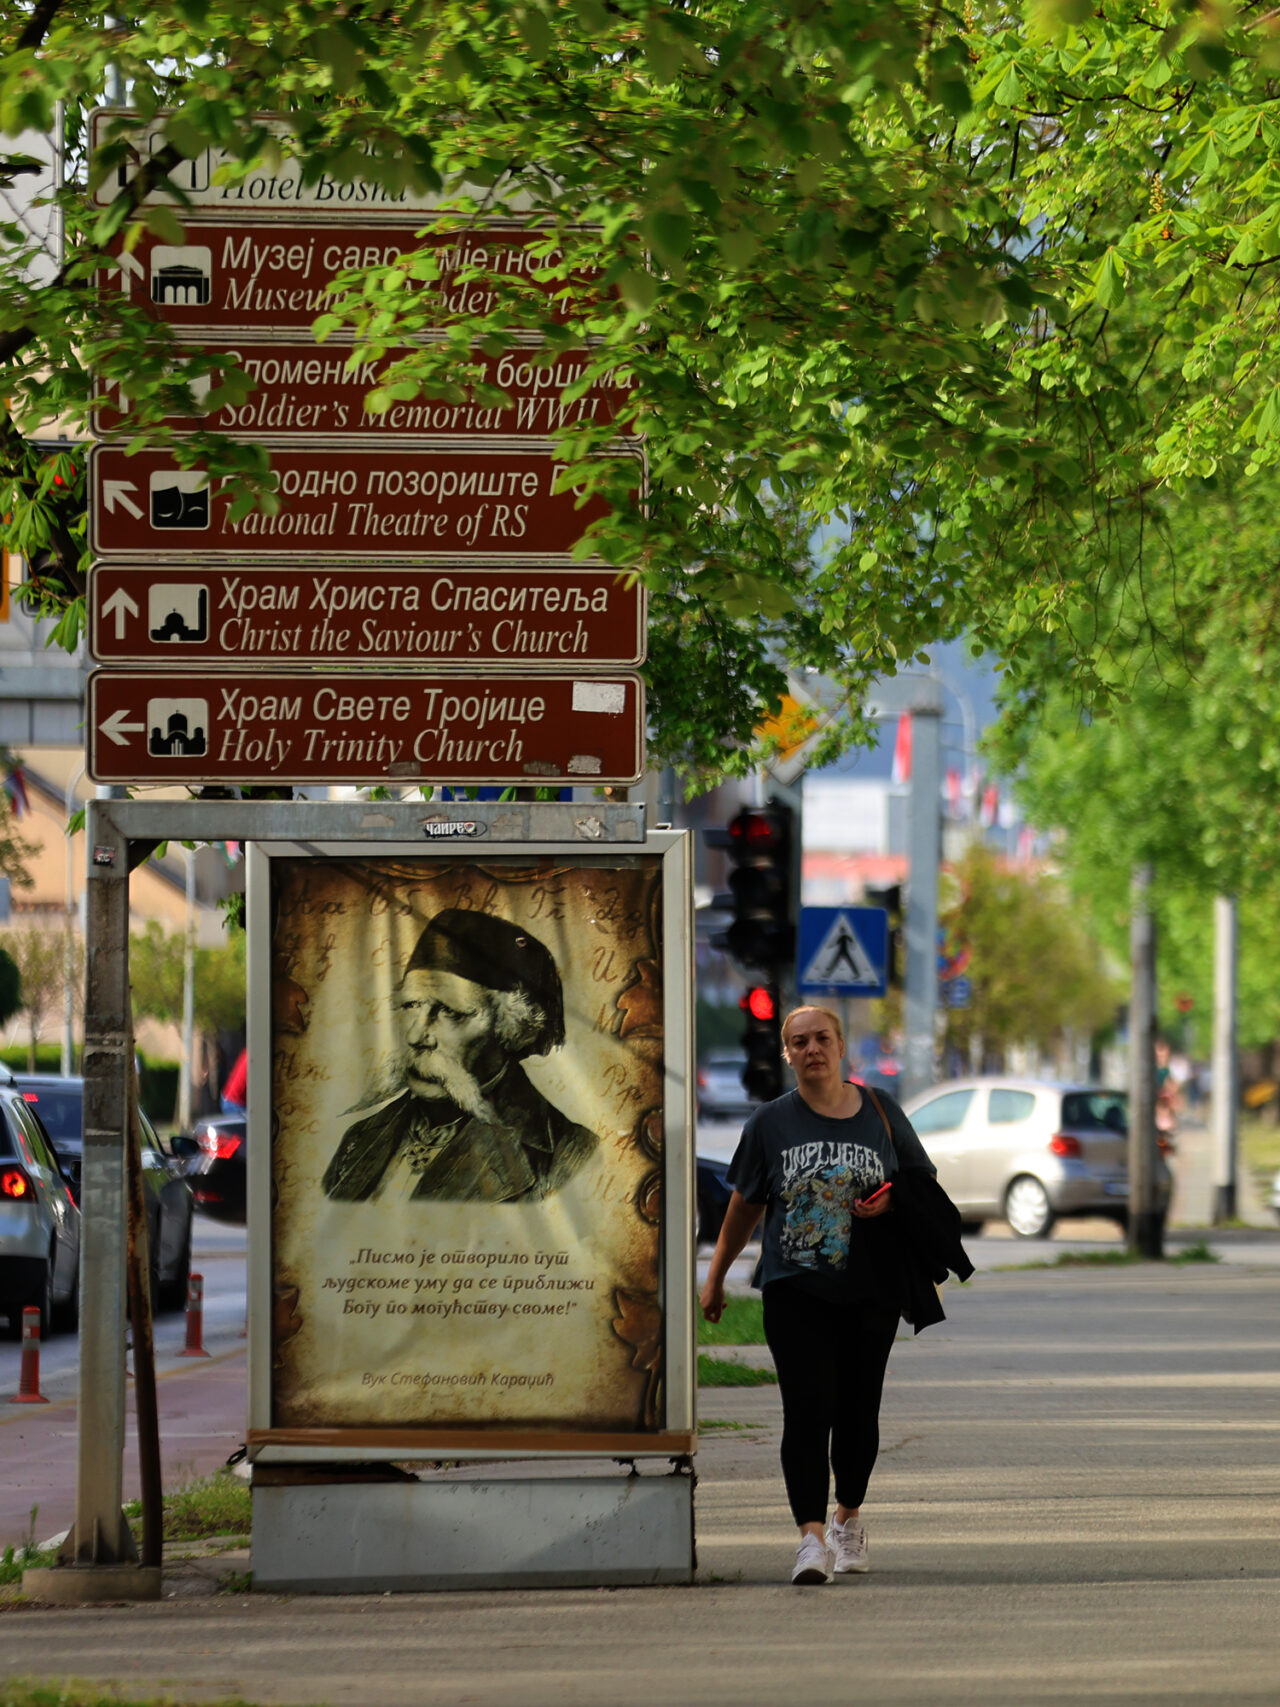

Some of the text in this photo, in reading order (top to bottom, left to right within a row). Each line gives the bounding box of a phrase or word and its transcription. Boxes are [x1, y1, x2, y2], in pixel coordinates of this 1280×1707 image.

[220, 235, 315, 279] Музеј
[359, 396, 503, 430] Memorial
[516, 396, 601, 431] WWII
[366, 470, 539, 504] позориште
[347, 502, 449, 537] Theatre
[456, 503, 490, 546] of
[489, 503, 530, 537] RS
[217, 576, 609, 619] Храм Христа Спаситеља
[219, 616, 589, 653] Christ the Saviour’s Church
[216, 686, 546, 730] Храм Свете Тројице
[216, 727, 525, 771] Holy Trinity Church
[418, 1249, 435, 1268] је
[321, 1277, 409, 1292] људскоме
[414, 1278, 448, 1292] уму
[452, 1278, 475, 1292] да
[478, 1278, 498, 1291] се
[360, 1371, 555, 1391] Вук Стефановић Караџић
